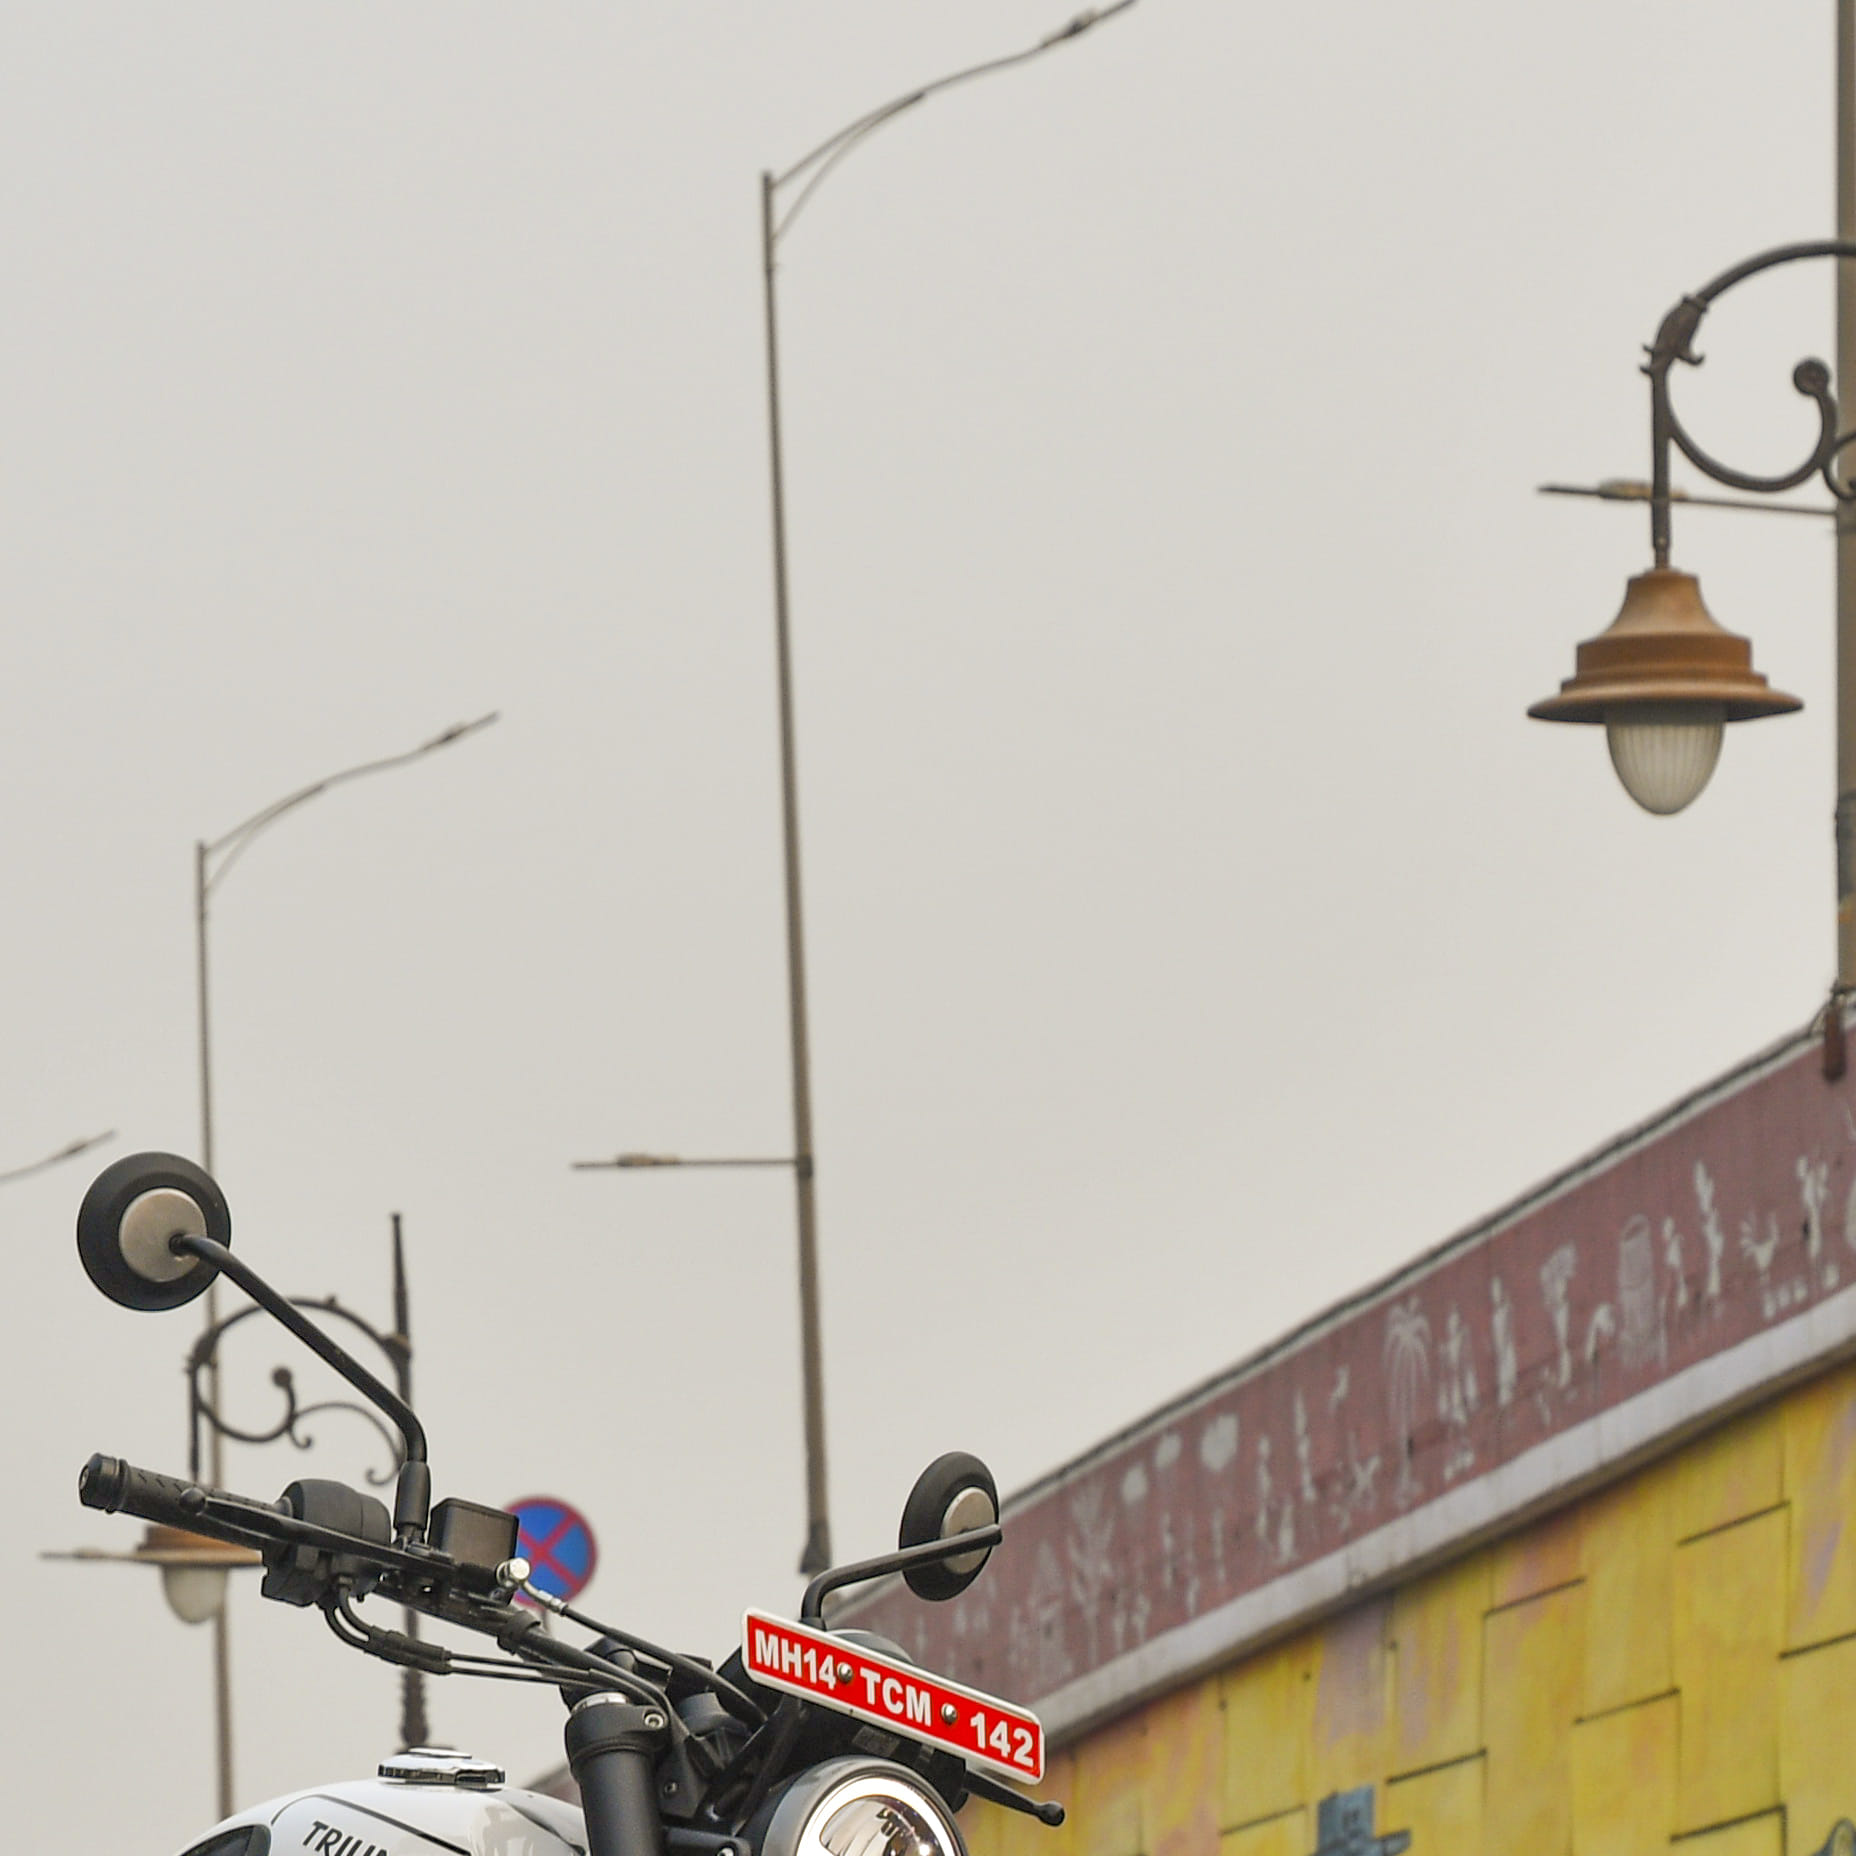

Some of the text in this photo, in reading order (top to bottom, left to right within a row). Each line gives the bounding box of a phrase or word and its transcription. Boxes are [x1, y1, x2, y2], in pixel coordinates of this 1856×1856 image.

[754, 1628, 1035, 1767] MH14 TCM 142
